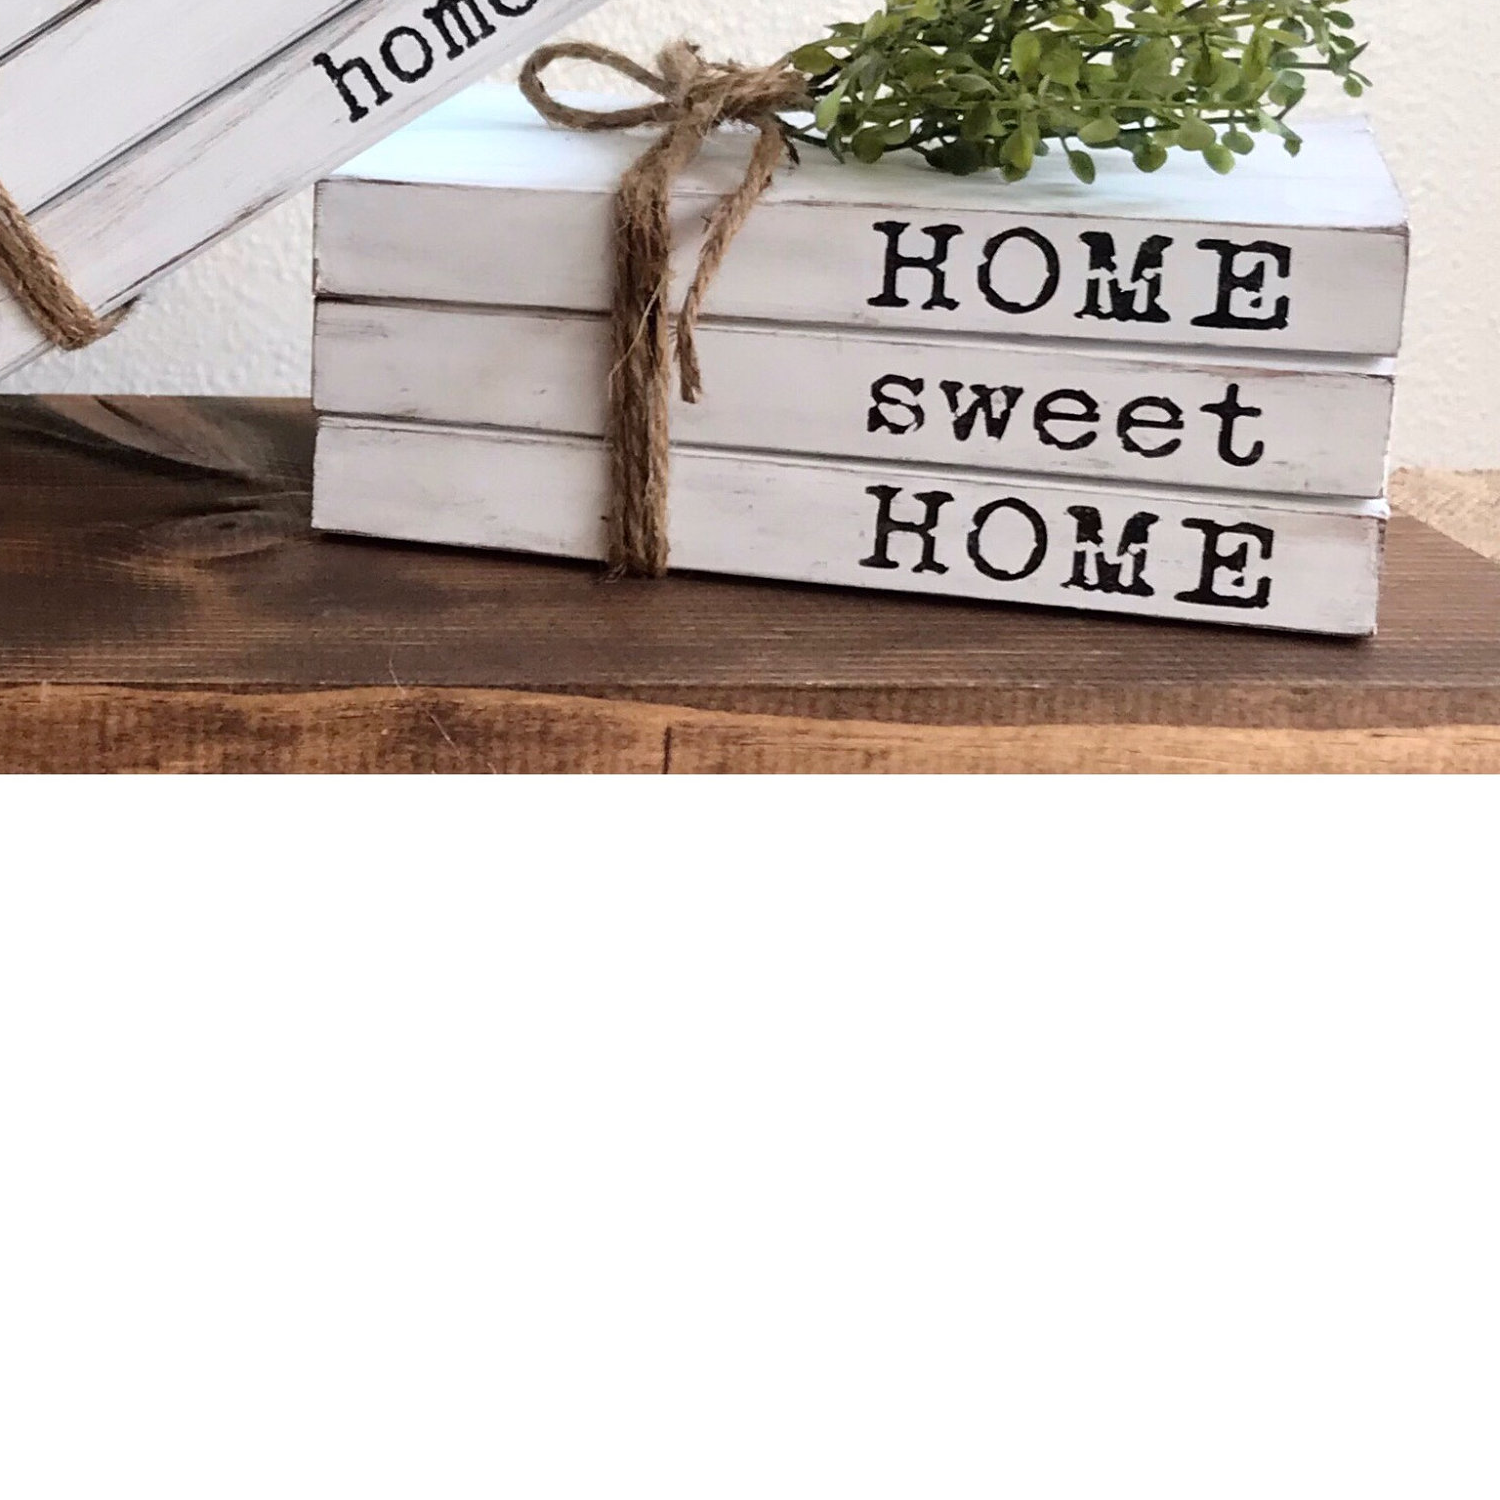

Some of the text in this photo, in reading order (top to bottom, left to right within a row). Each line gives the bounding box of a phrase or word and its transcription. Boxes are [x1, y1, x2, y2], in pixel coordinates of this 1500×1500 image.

[867, 220, 1292, 331] HOME
[868, 373, 1266, 467] sweet
[858, 484, 1275, 609] HOME
